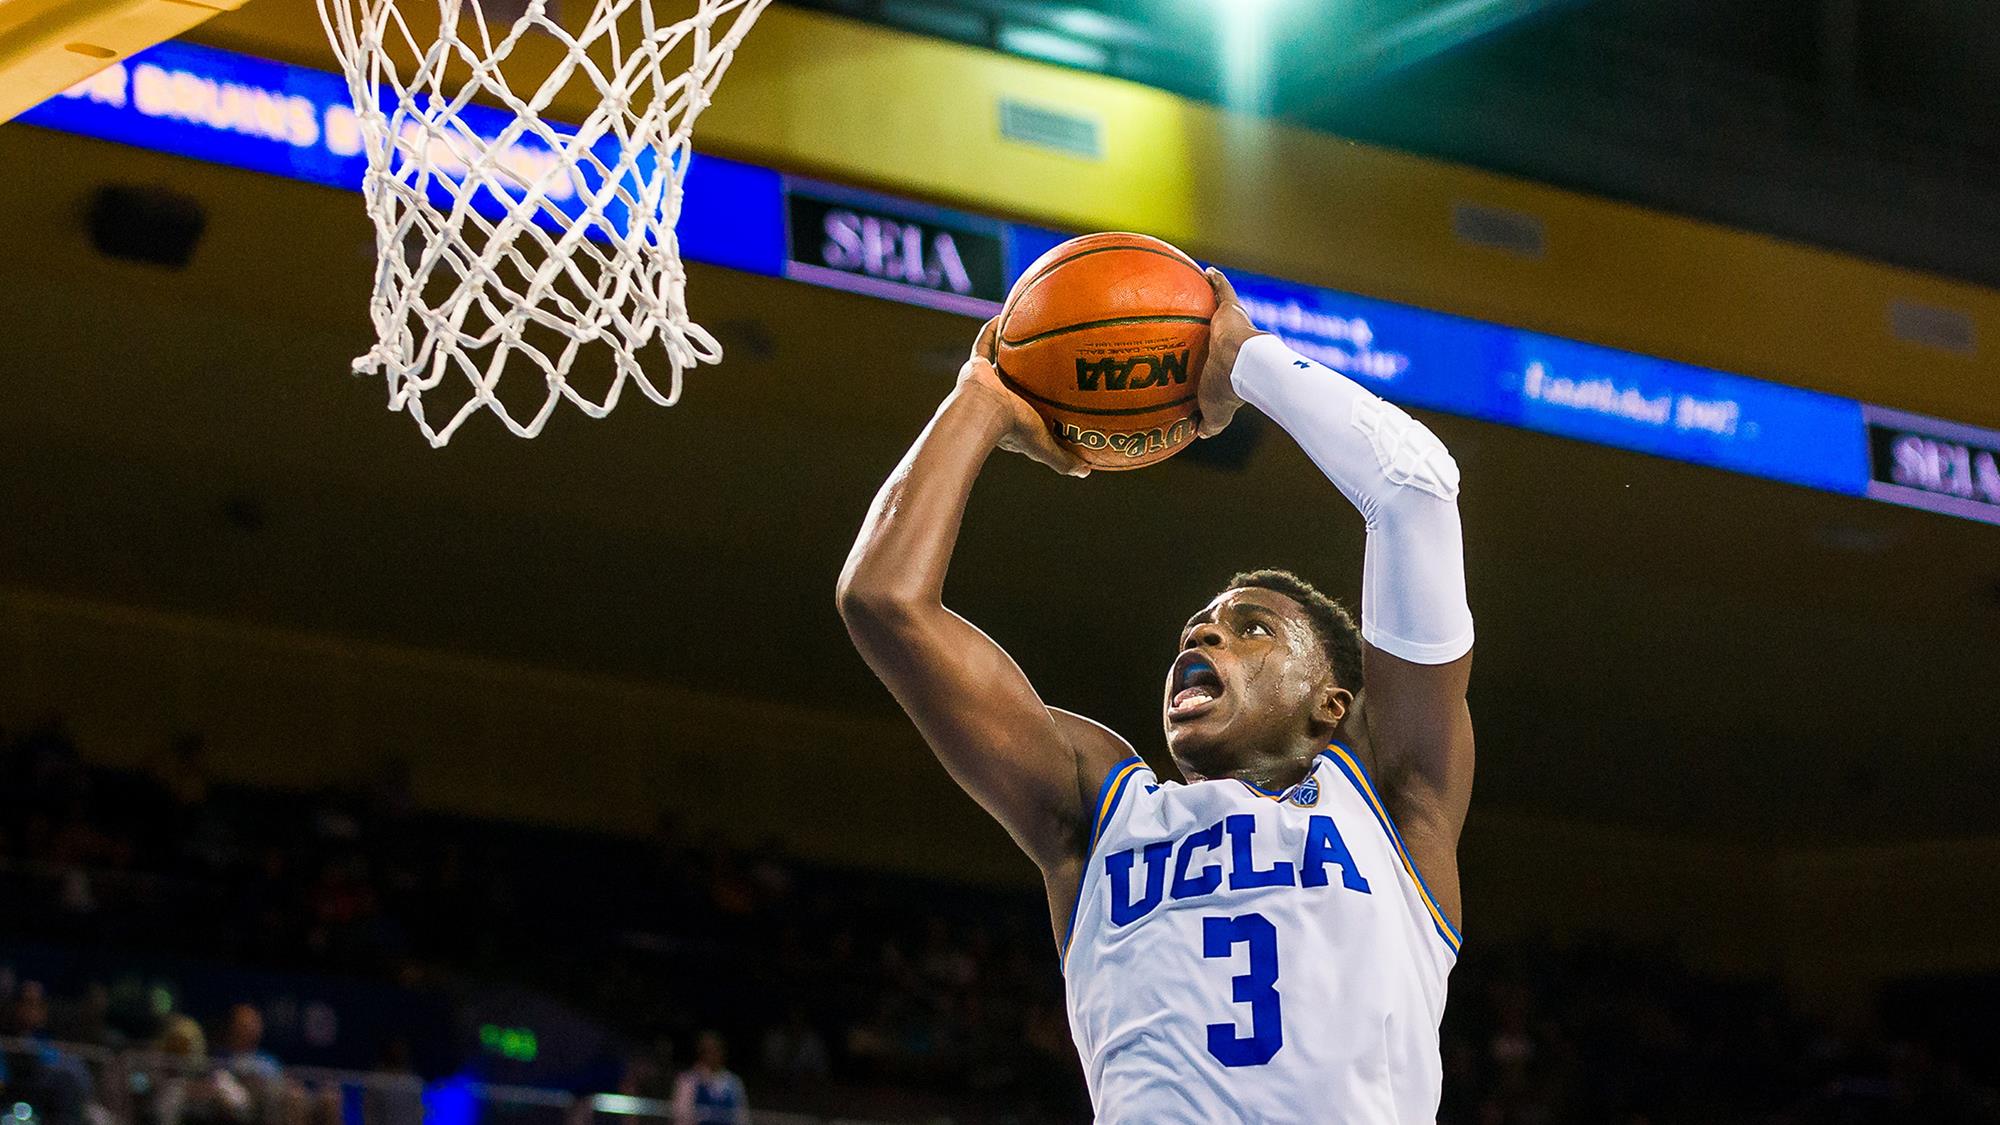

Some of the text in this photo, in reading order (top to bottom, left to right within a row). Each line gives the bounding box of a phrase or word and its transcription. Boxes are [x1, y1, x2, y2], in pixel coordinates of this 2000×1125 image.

[133, 62, 318, 148] BRUINS
[823, 208, 972, 294] SEIA
[1076, 349, 1189, 391] NCAA
[1105, 814, 1372, 927] UCLA
[1202, 912, 1283, 1067] 3
